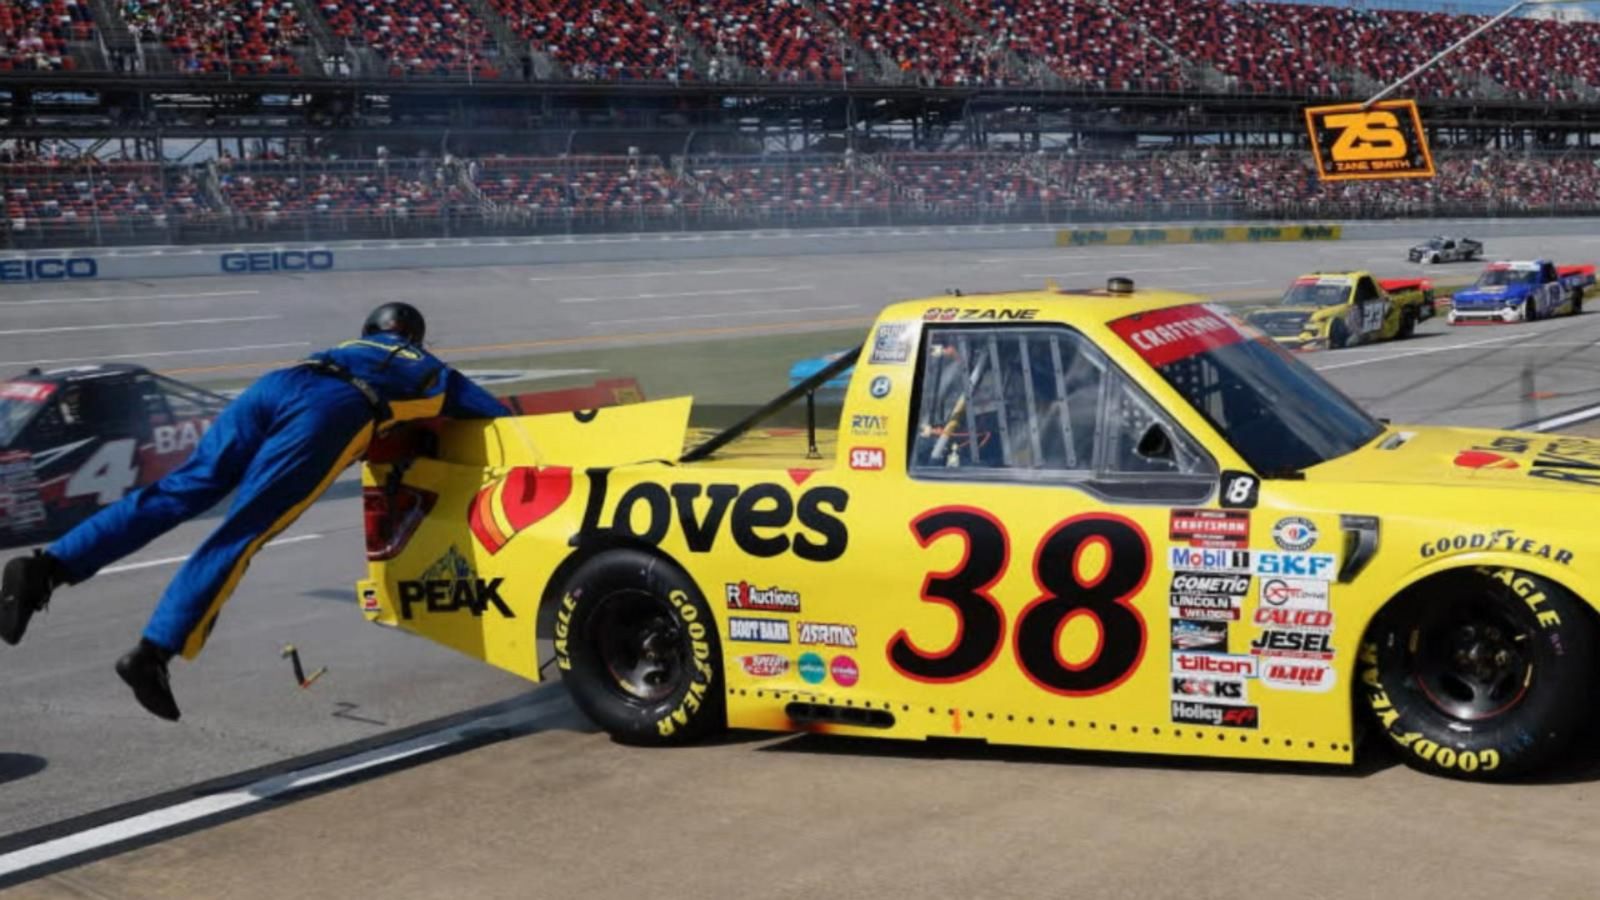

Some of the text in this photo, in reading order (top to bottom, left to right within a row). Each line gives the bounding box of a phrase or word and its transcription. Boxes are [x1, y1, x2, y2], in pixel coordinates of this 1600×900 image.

[1324, 111, 1407, 161] ZS
[221, 250, 334, 272] GEICO
[959, 308, 1040, 320] ZANE
[852, 449, 883, 468] SEM
[66, 438, 138, 505] 4
[1172, 548, 1249, 568] Mobil 1
[1420, 529, 1574, 565] GOODYEAR
[1257, 554, 1333, 575] SKF
[397, 577, 516, 620] PEAK
[886, 504, 1152, 697] 38
[1172, 595, 1230, 609] LINCOLN
[1254, 609, 1333, 627] CALICO
[554, 592, 578, 671] EAGLE
[1251, 631, 1335, 653] JESEL
[656, 589, 713, 737] GOODYEAR
[1177, 655, 1252, 675] tilton
[1172, 702, 1224, 724] Holley
